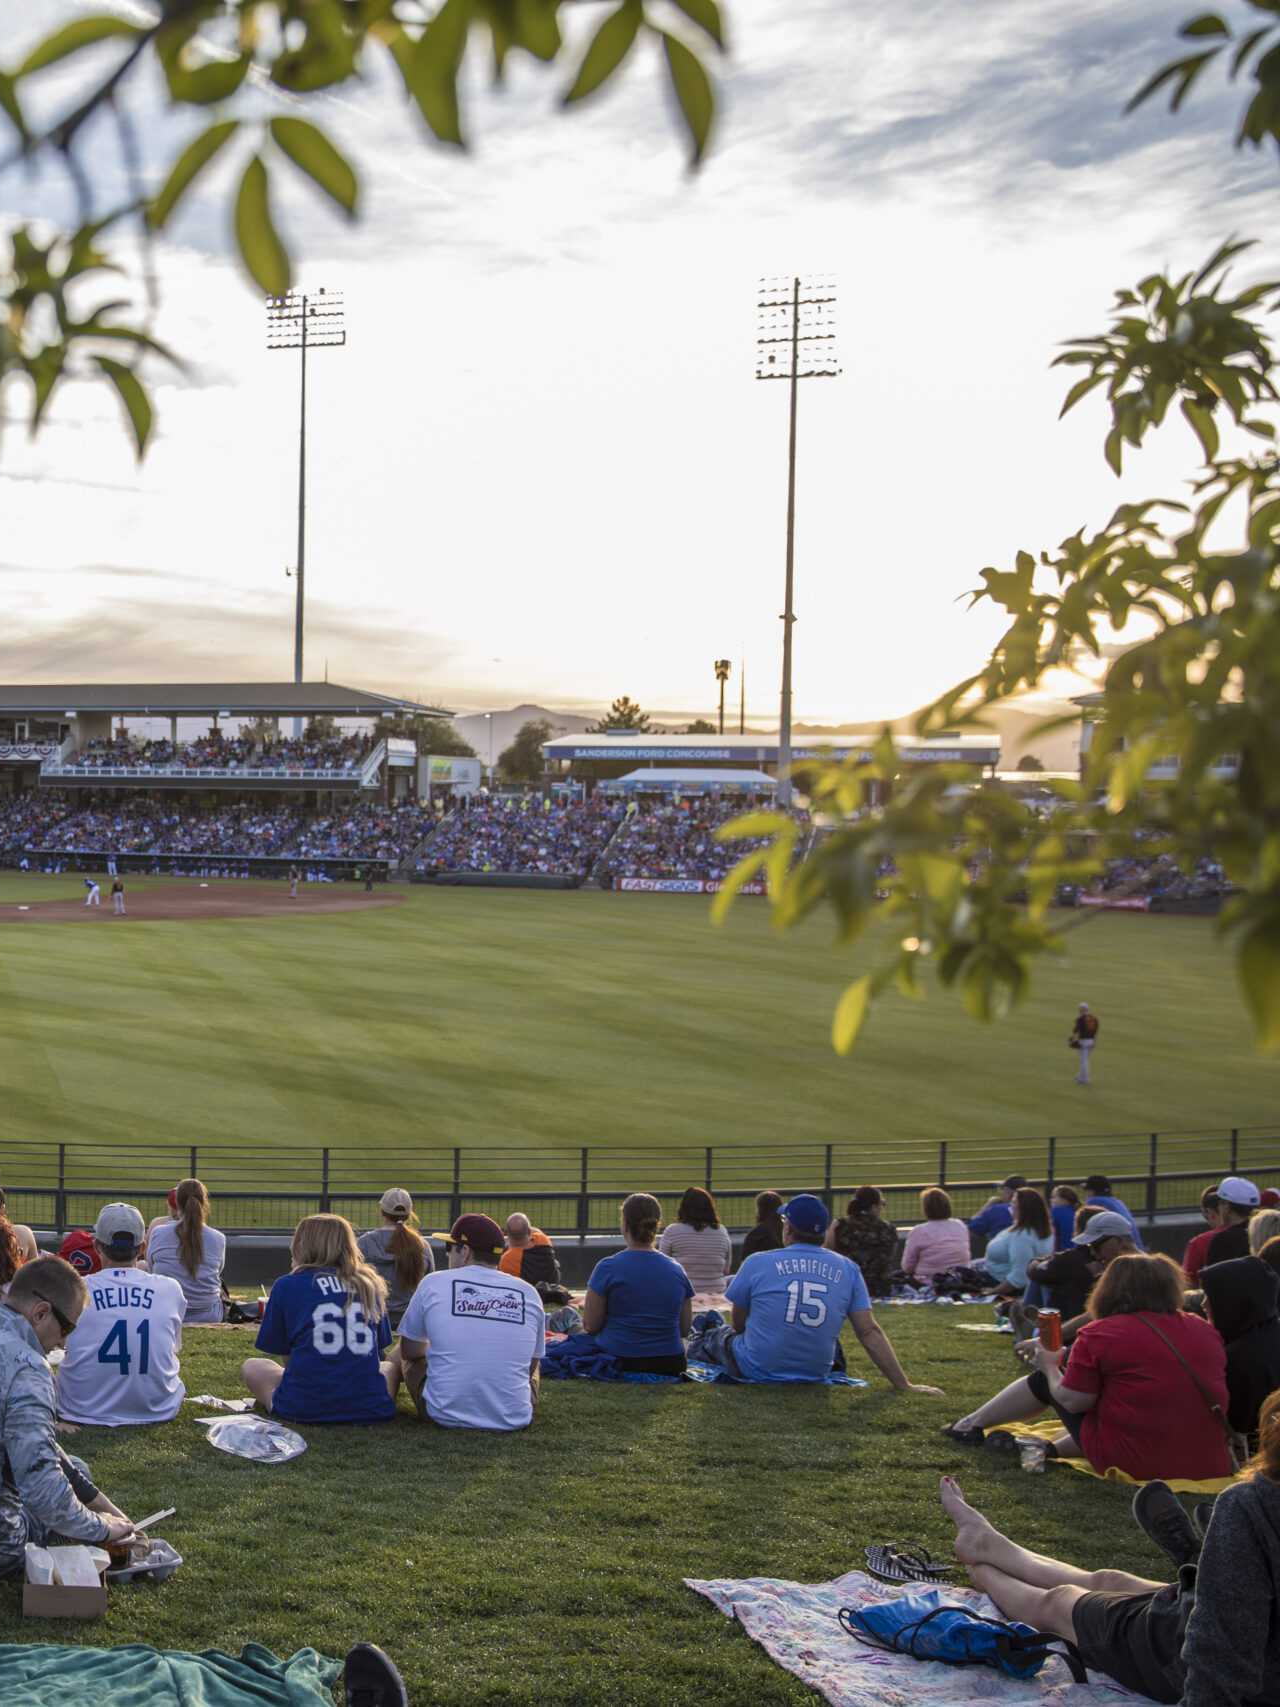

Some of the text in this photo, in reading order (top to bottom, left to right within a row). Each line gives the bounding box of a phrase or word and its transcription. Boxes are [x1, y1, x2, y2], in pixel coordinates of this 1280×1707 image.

[574, 749, 731, 759] SANDERSON FORD CONCOURSE
[791, 750, 859, 760] SANDRSO
[897, 750, 962, 760] ONCOURSE
[622, 879, 700, 892] FASTSIGNS
[705, 882, 762, 895] Gledale
[775, 1258, 842, 1284] MERRIFIELD
[92, 1286, 155, 1311] REUSS
[456, 1299, 490, 1316] Salty
[488, 1299, 522, 1310] Crew
[784, 1279, 828, 1328] 15
[312, 1302, 374, 1355] 66
[97, 1318, 150, 1376] 41
